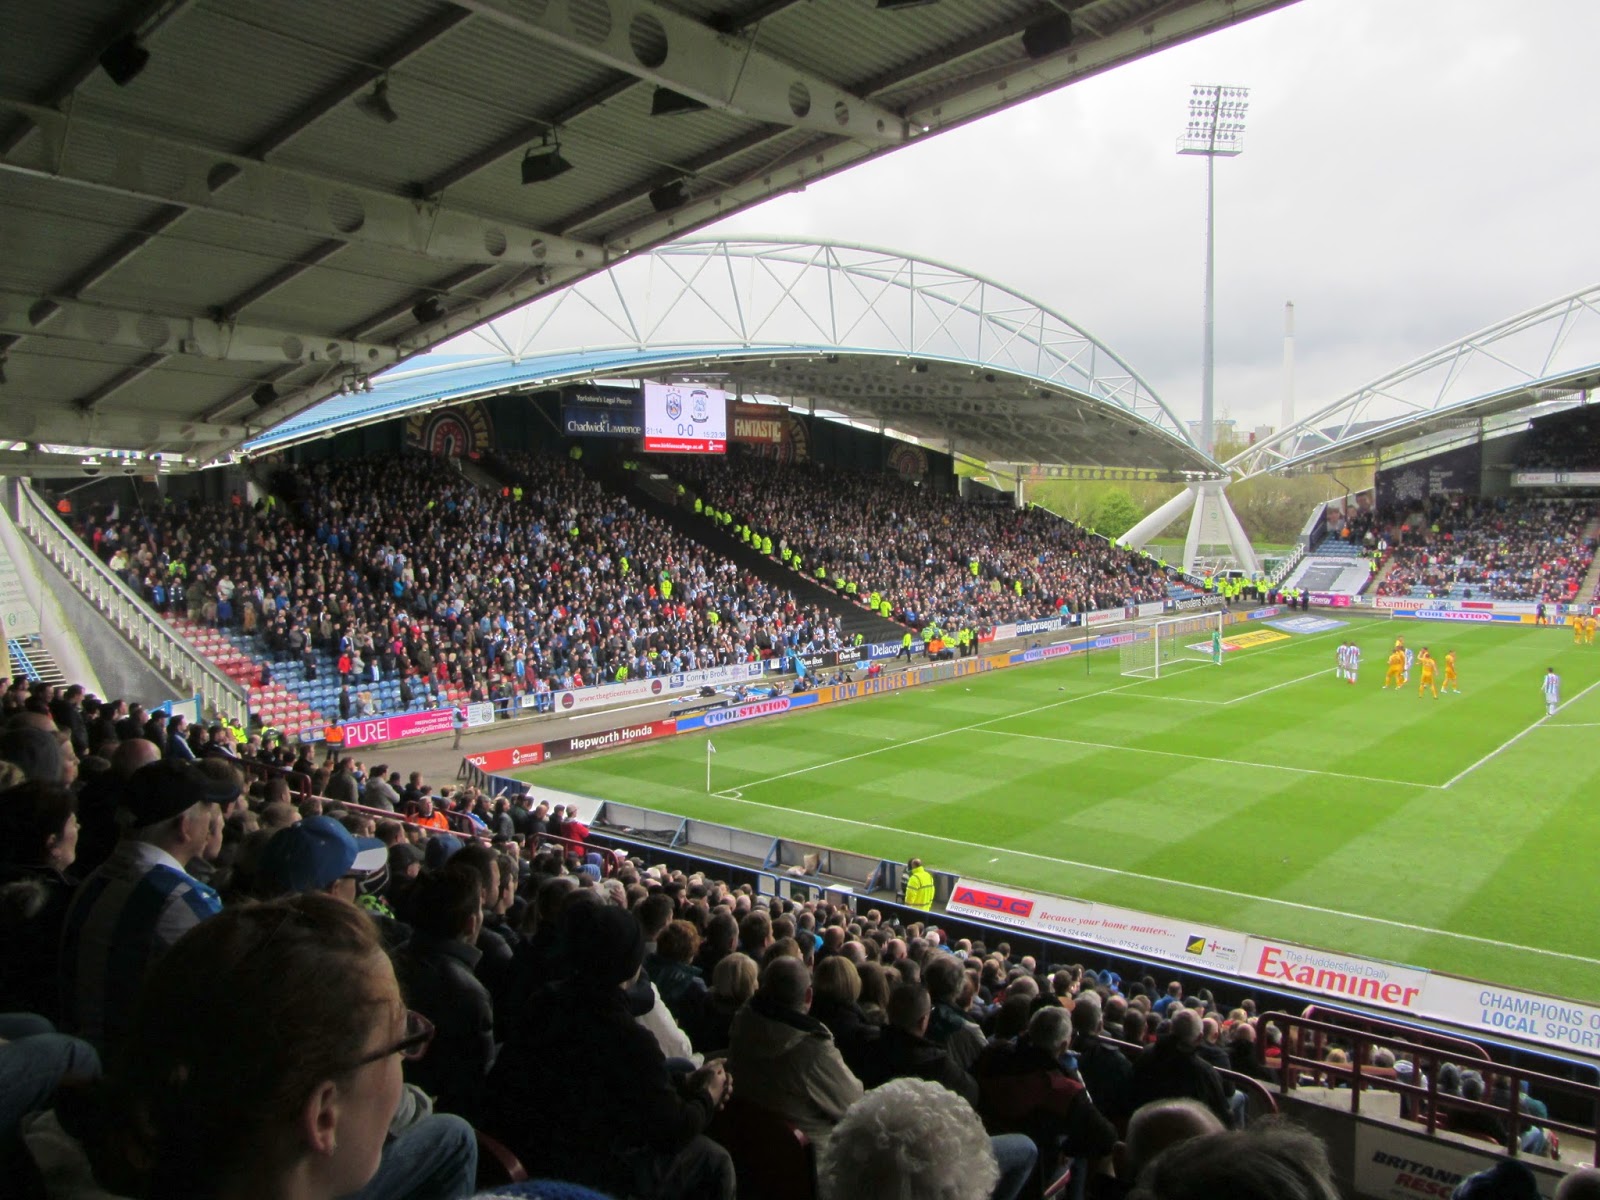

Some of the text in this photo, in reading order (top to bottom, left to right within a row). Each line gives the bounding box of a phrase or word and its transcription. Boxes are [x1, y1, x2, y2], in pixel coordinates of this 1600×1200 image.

[567, 420, 642, 434] Chadwick Lawrence
[646, 427, 663, 435] 21:14
[734, 418, 782, 438] FANTASTIC
[1376, 598, 1425, 610] Examiner
[1418, 610, 1491, 620] TOOLSTATION
[1025, 646, 1070, 659] TOOLSTATION
[831, 684, 859, 700] LOW
[863, 672, 907, 694] PRICES
[706, 699, 789, 724] TOOLSTATION
[346, 721, 388, 745] PURE
[570, 731, 620, 750] Hepworth
[621, 725, 653, 740] Honda
[950, 905, 982, 916] PROPERTY
[982, 911, 1013, 923] SERVICES
[1040, 911, 1176, 938] Because your home matters...
[1047, 924, 1066, 934] 01924
[1067, 928, 1080, 937] 524
[1080, 931, 1093, 939] 648
[1119, 939, 1139, 950] 07525
[1140, 944, 1153, 953] 465
[1154, 948, 1167, 956] 511
[1256, 945, 1420, 1007] Examiner
[1285, 950, 1390, 981] The Huddersfield Daily
[1480, 991, 1584, 1026] CHAMPIONS
[1482, 1009, 1539, 1035] LOCAL
